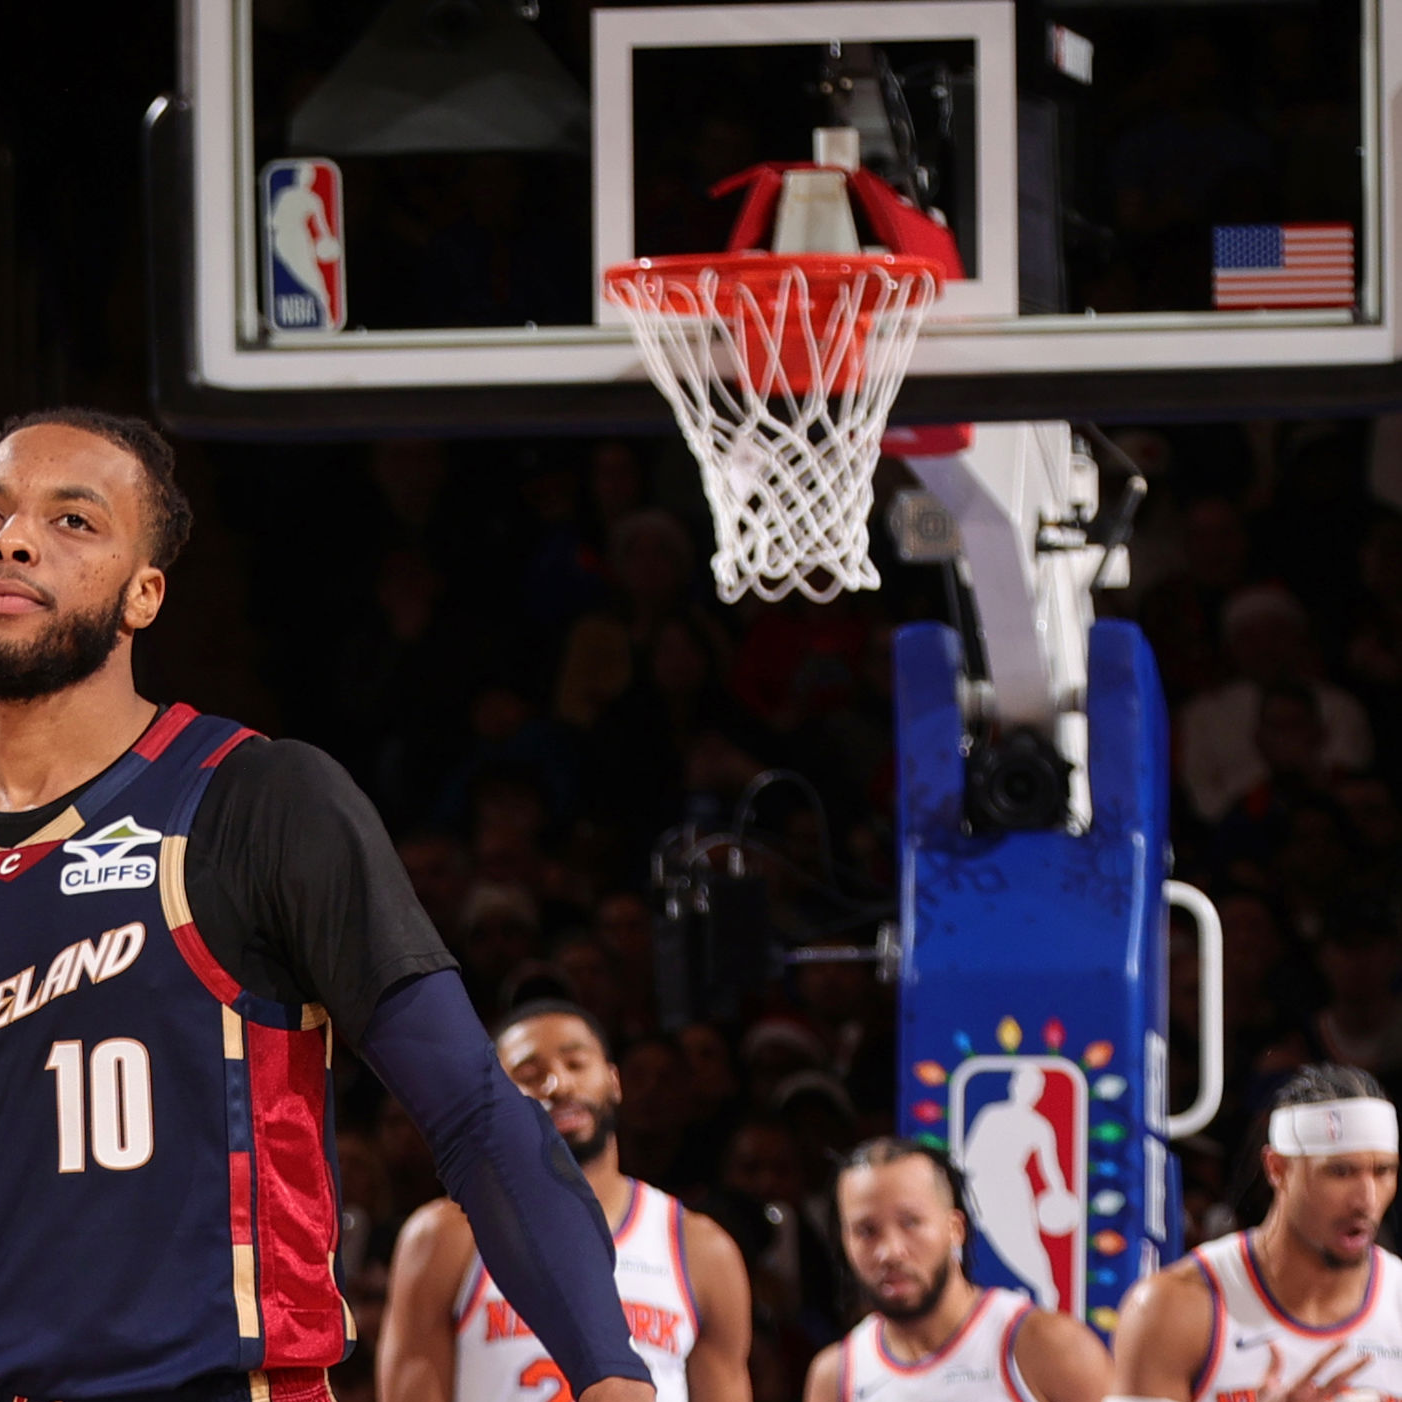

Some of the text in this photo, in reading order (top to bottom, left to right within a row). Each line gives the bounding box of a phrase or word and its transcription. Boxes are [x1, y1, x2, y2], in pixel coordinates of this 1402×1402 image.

[281, 296, 318, 326] NBA
[64, 863, 152, 888] CLIFFS
[44, 1036, 155, 1174] 10
